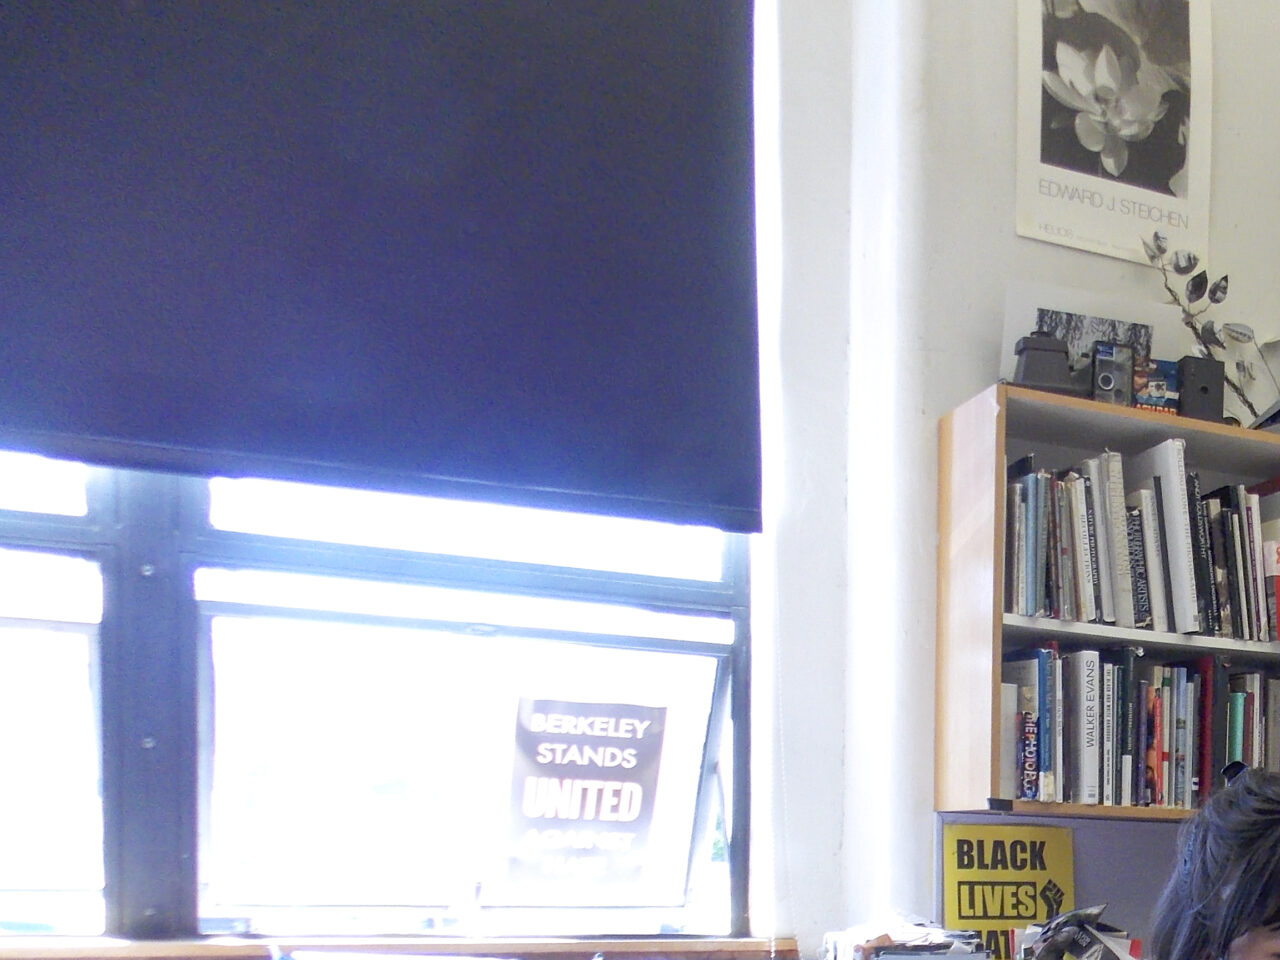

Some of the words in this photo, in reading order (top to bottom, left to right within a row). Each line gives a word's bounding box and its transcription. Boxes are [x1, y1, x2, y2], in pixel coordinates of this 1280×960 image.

[1039, 178, 1104, 209] EDWARD
[1119, 199, 1189, 230] STEICHEN
[1137, 578, 1150, 612] ARTISTS
[1085, 660, 1096, 702] EVANS
[529, 712, 652, 740] BERKELEY
[1086, 705, 1095, 748] WALKER
[535, 743, 638, 769] STANDS
[521, 775, 643, 823] UNITED
[957, 839, 1047, 871] BLACK
[959, 884, 1036, 918] LIVES
